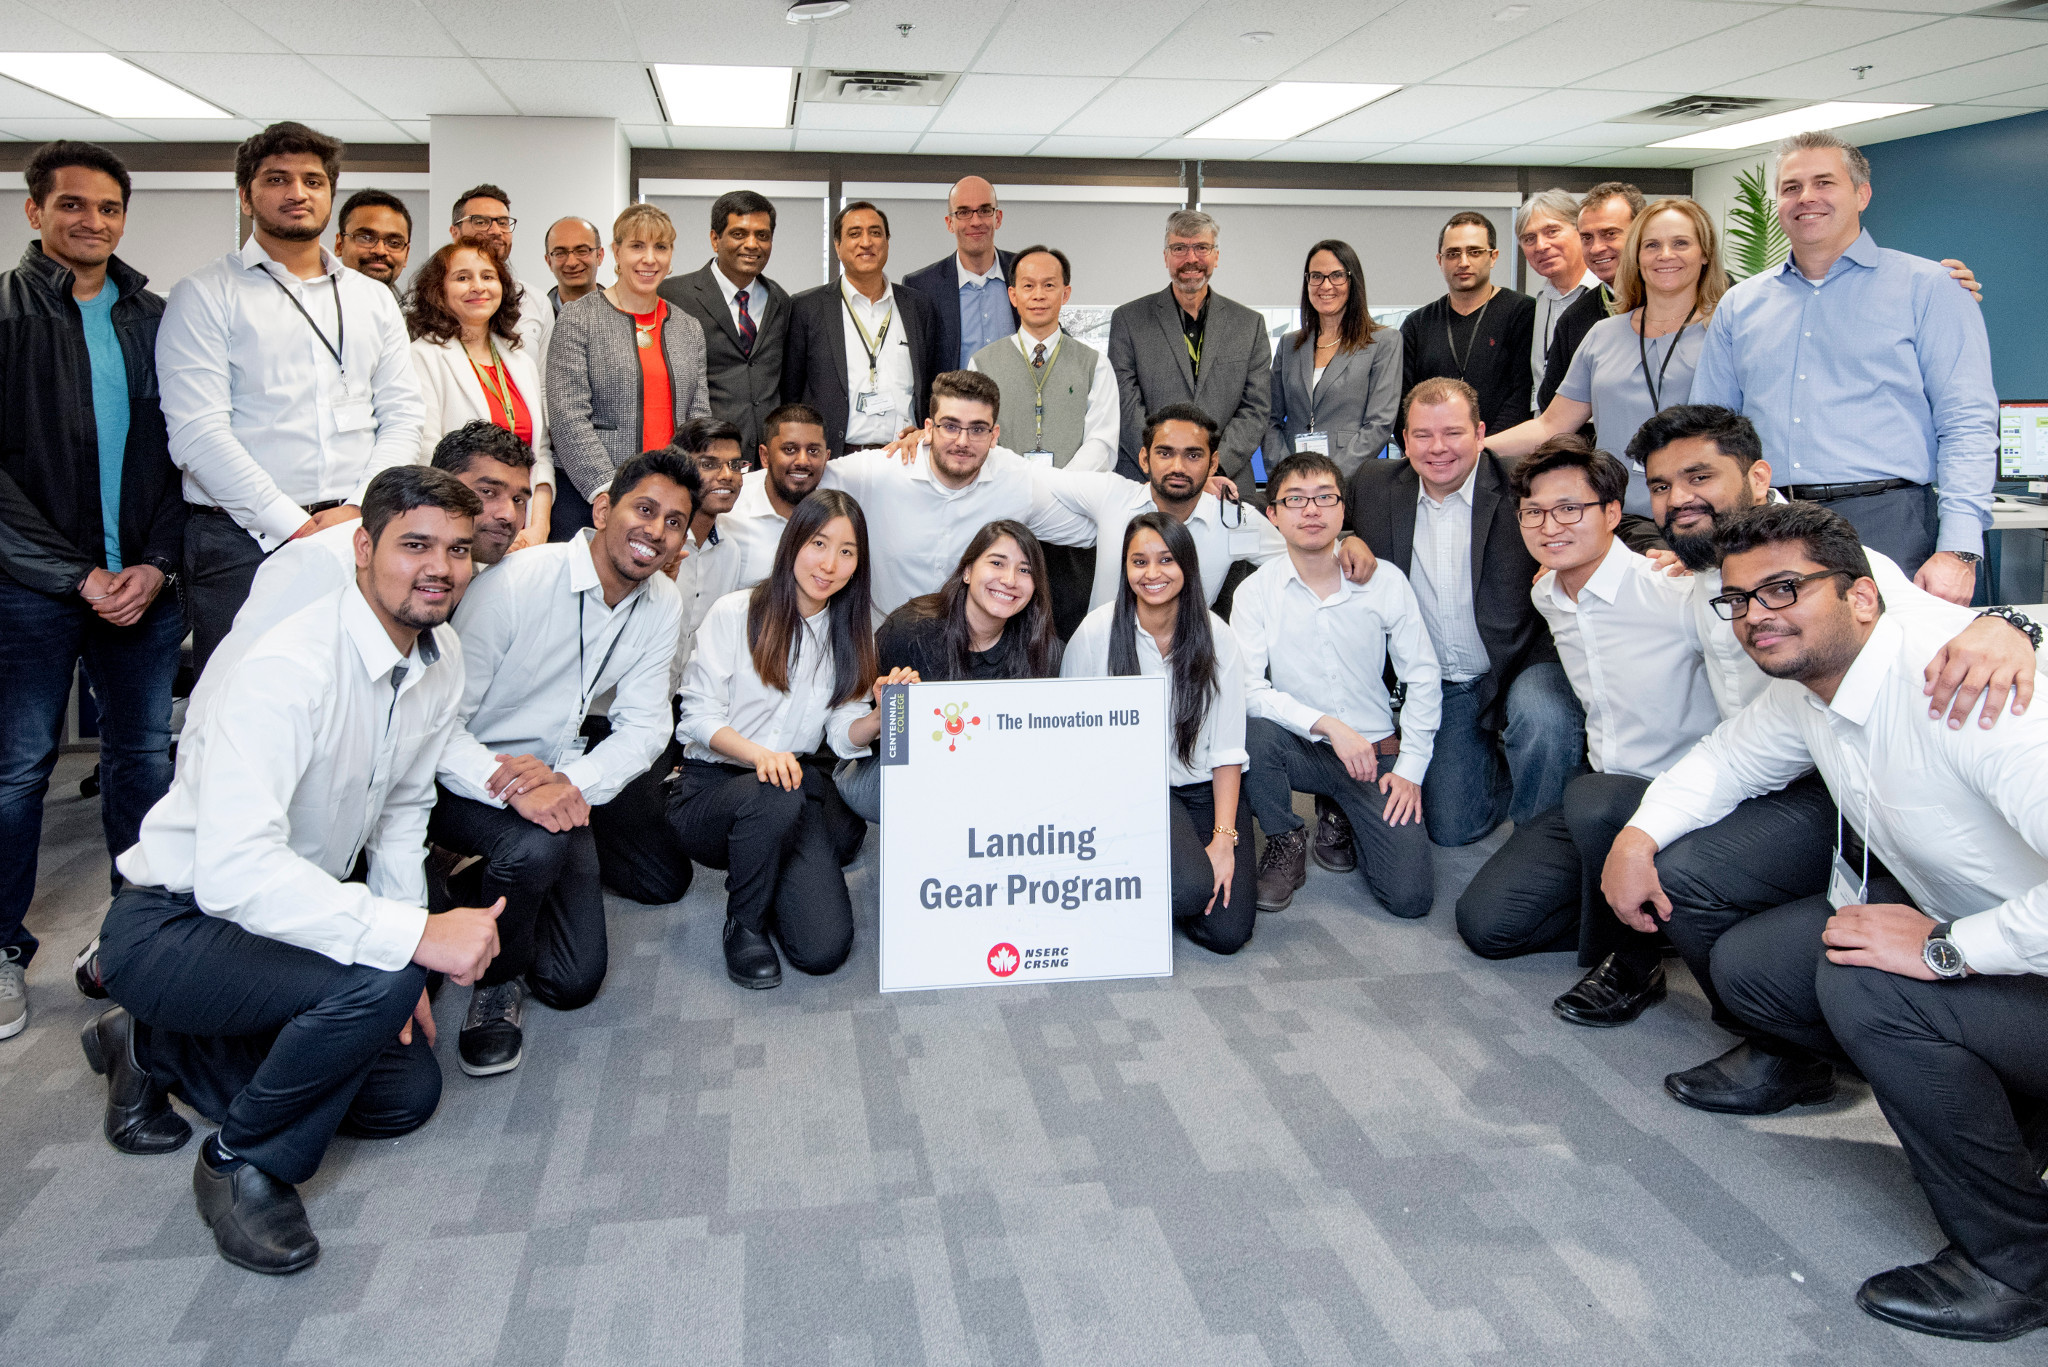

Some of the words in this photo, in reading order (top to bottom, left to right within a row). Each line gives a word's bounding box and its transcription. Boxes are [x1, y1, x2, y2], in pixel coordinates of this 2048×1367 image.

[889, 693, 897, 758] CENTENNIAL
[897, 693, 905, 733] COLLEGE
[996, 713, 1023, 730] The
[1028, 711, 1103, 729] Innovation
[1109, 709, 1140, 726] HUB
[968, 824, 1096, 861] Landing
[919, 877, 998, 910] Gear
[1007, 873, 1142, 911] Program
[1024, 958, 1069, 970] CRSNG
[1025, 947, 1069, 958] NSERC
